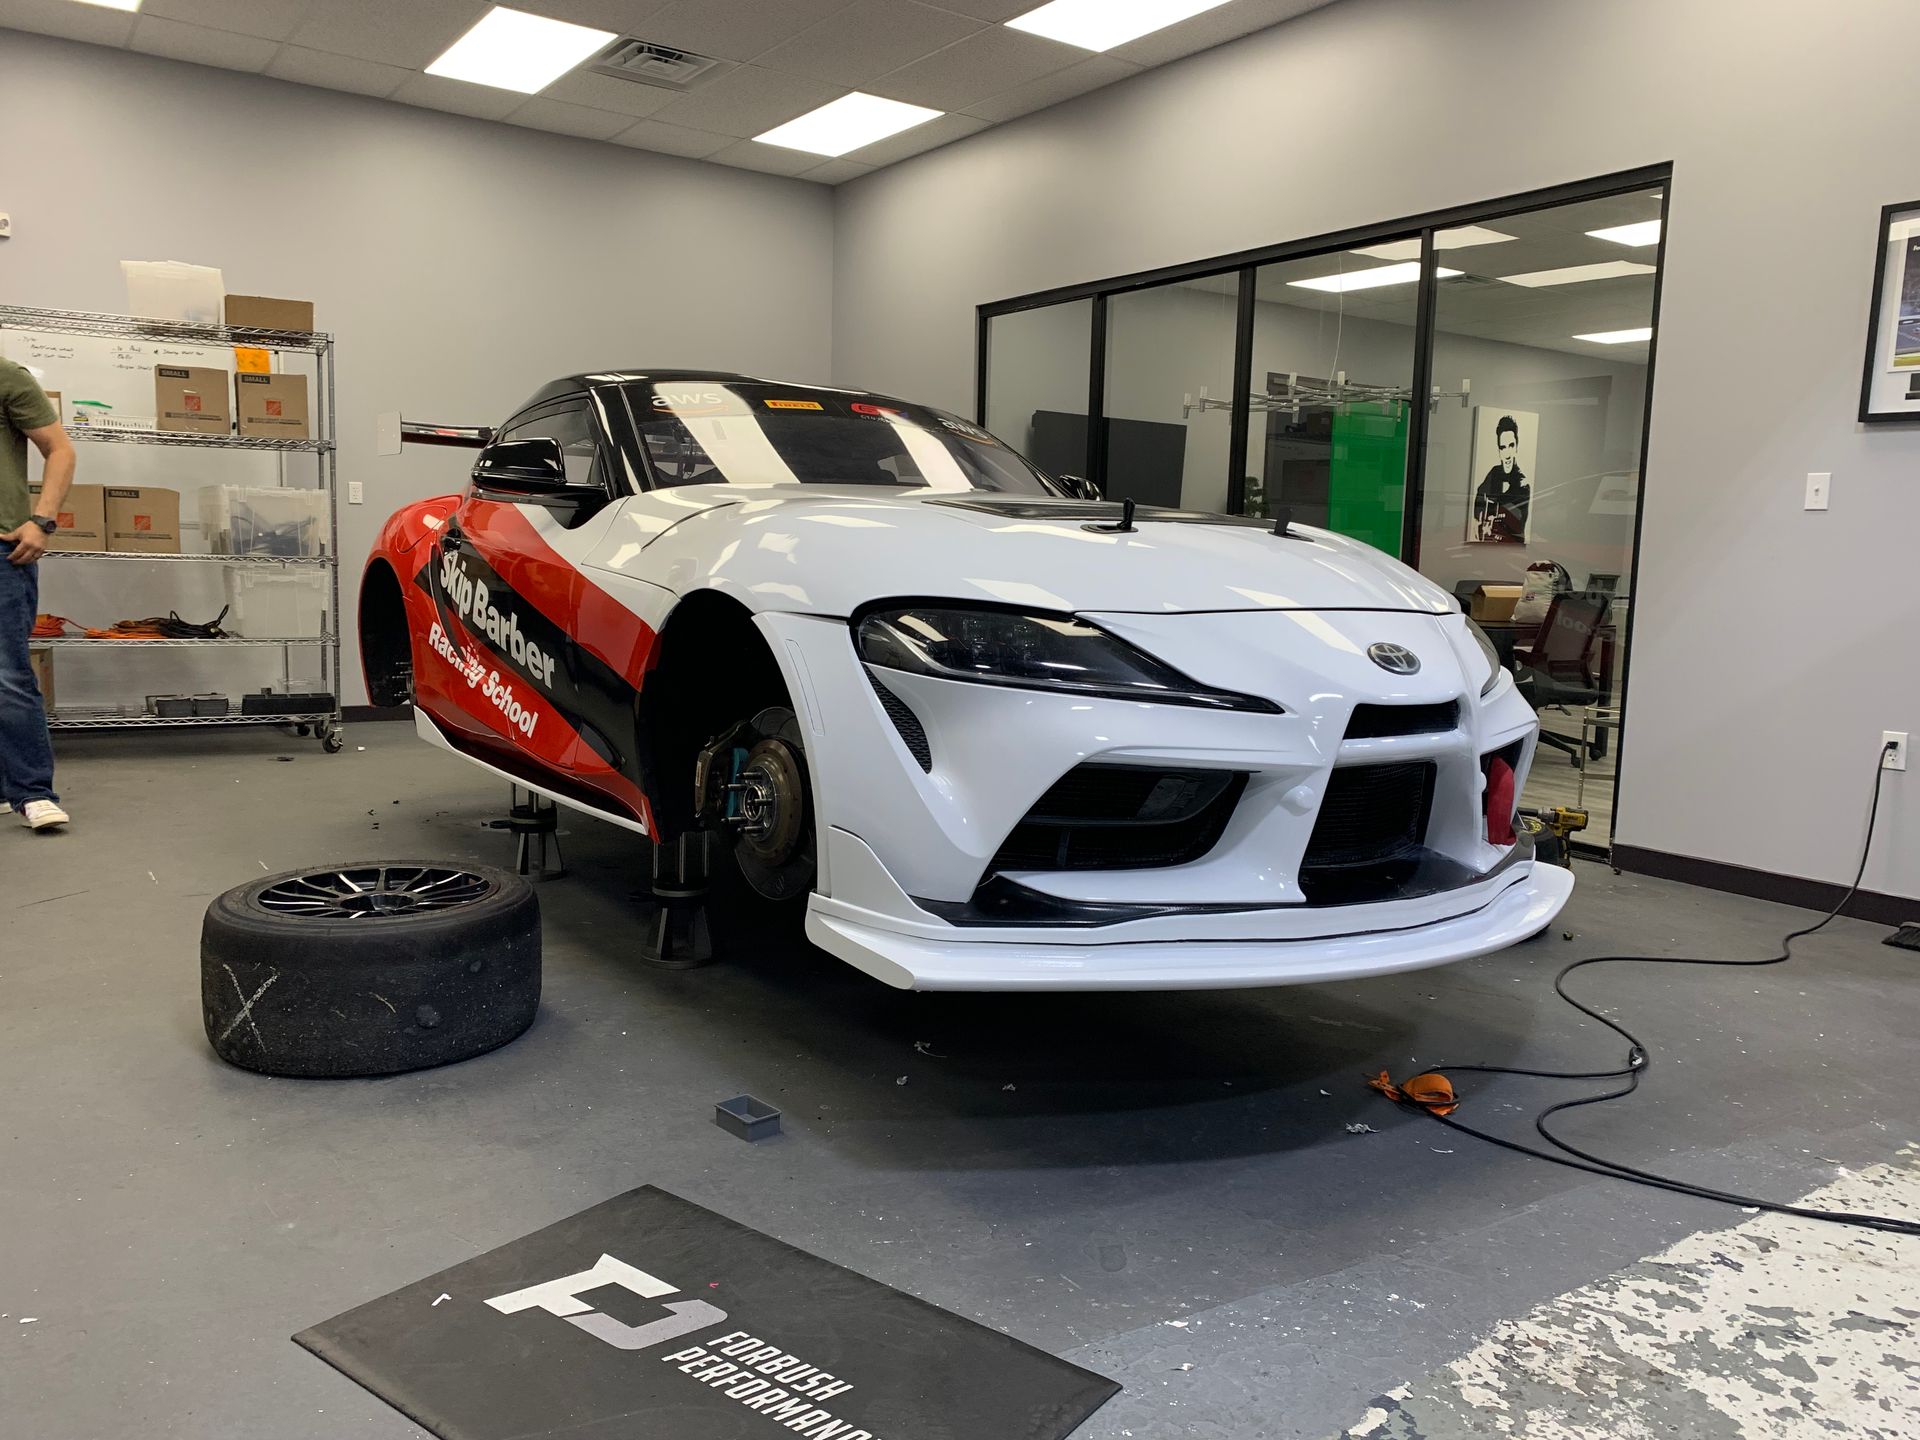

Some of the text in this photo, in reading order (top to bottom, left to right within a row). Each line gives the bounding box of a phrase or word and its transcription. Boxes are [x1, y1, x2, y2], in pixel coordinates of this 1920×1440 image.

[160, 369, 188, 378] SMALL
[243, 375, 269, 384] SMALL
[651, 392, 723, 407] aws
[110, 489, 138, 497] SMALL
[440, 550, 555, 690] Skip Barber
[428, 622, 539, 739] Racing School
[705, 1330, 854, 1402] FORBUSH
